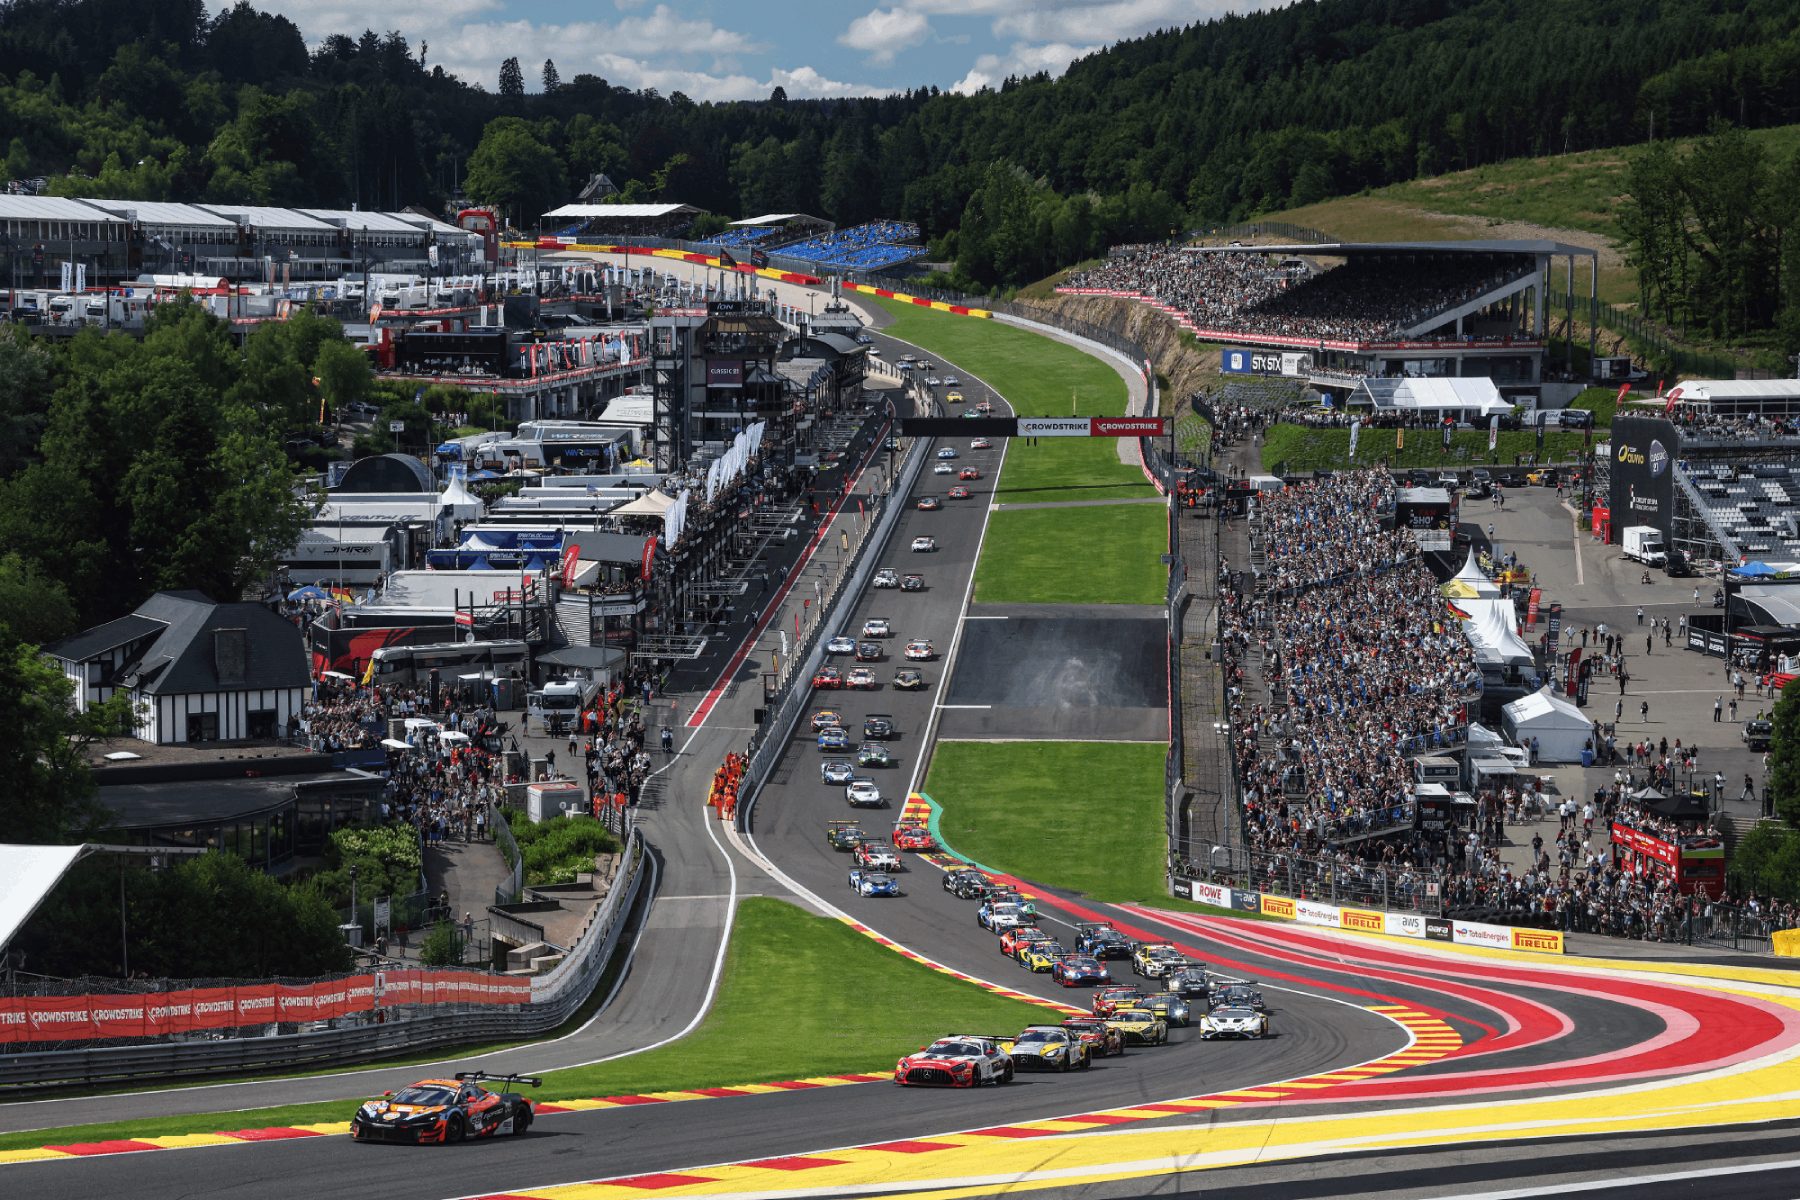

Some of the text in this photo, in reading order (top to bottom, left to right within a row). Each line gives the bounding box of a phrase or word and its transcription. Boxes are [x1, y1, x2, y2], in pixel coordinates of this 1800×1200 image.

[1199, 885, 1222, 900] ROWE
[1242, 892, 1256, 904] aws
[1263, 897, 1293, 916] PIRELLI
[1307, 908, 1339, 922] TotalEnergies
[1343, 911, 1381, 930] PIRELLI
[1402, 916, 1420, 928] aws
[1469, 929, 1509, 943] TotalEnergies
[1514, 932, 1558, 950] PIRELLI
[196, 1000, 234, 1014] CROWDSTRIKE
[240, 996, 275, 1010] CROWDSTRIKE
[32, 1010, 88, 1023] CROWDSTRIKE
[94, 1008, 143, 1021] CROWDSTRIKE
[150, 1003, 191, 1018] CROWDSTRIKE
